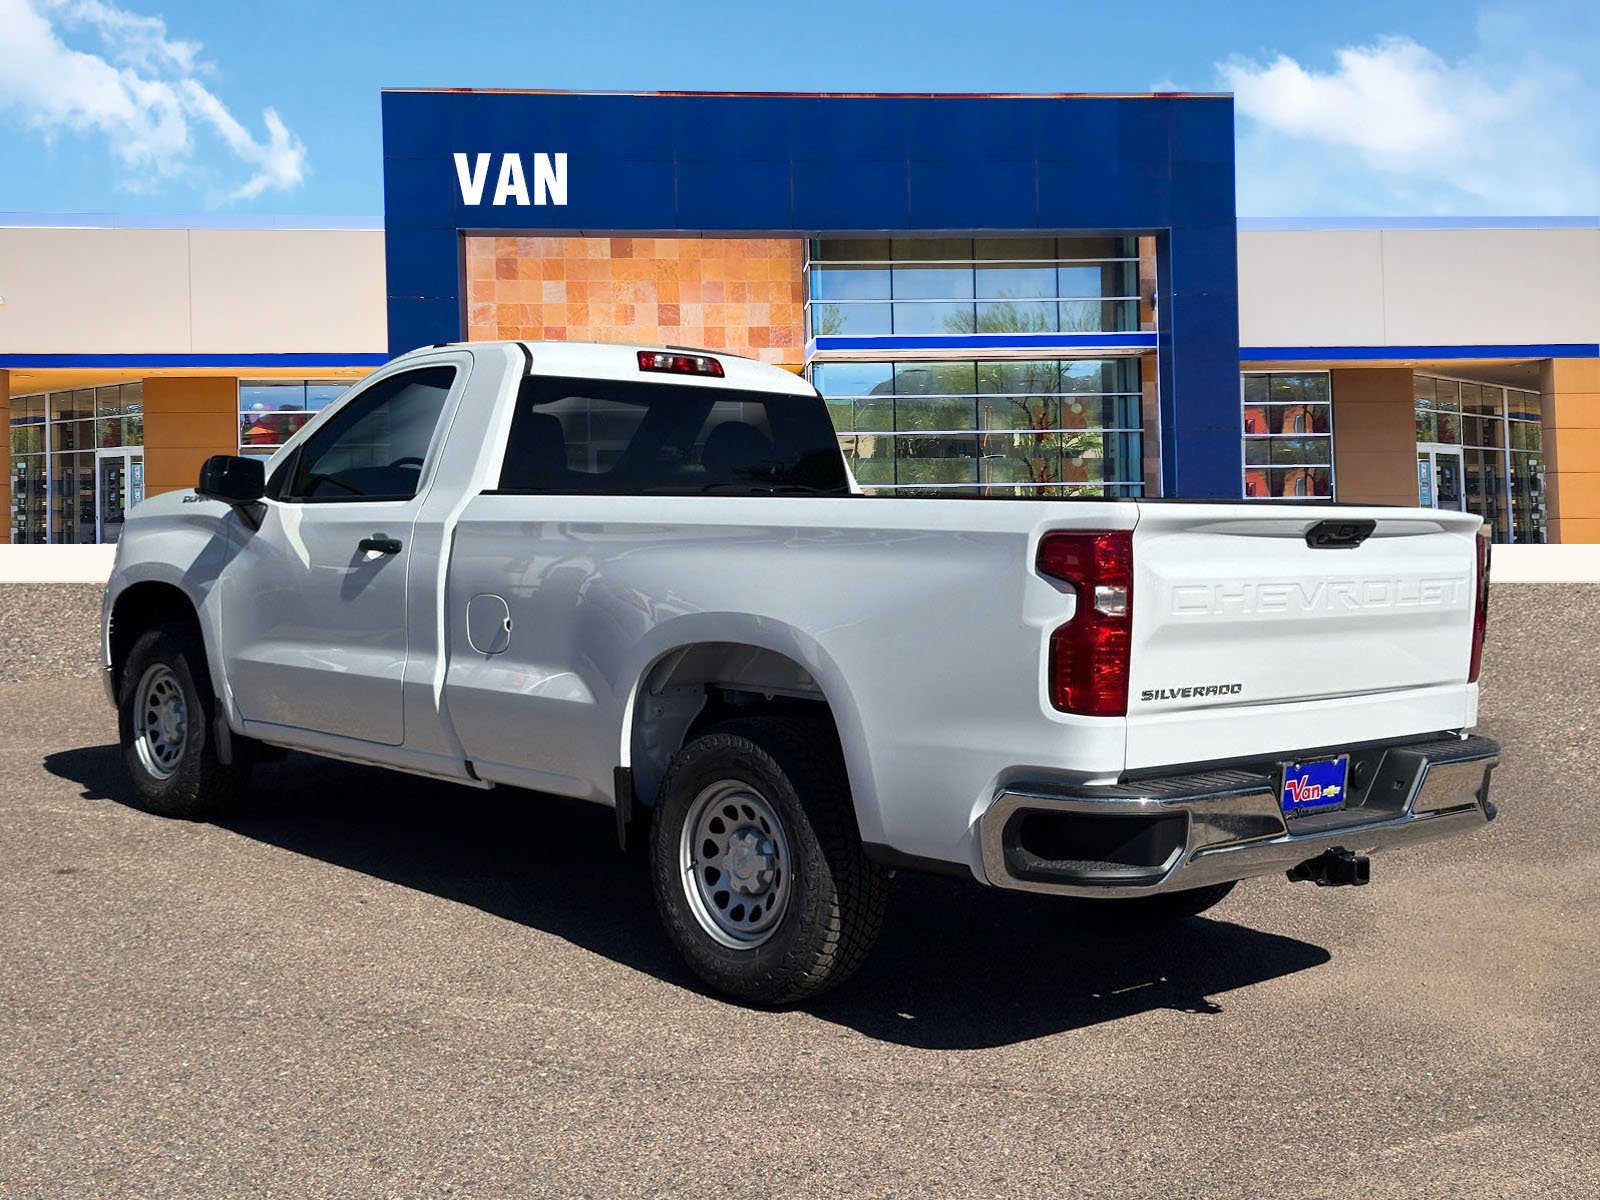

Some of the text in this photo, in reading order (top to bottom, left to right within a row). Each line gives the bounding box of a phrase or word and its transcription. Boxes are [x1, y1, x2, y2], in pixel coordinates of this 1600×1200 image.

[453, 152, 568, 206] VAN
[1171, 577, 1466, 616] CHEVROLET
[1140, 683, 1242, 702] SILVERADO
[1285, 775, 1321, 802] Van
